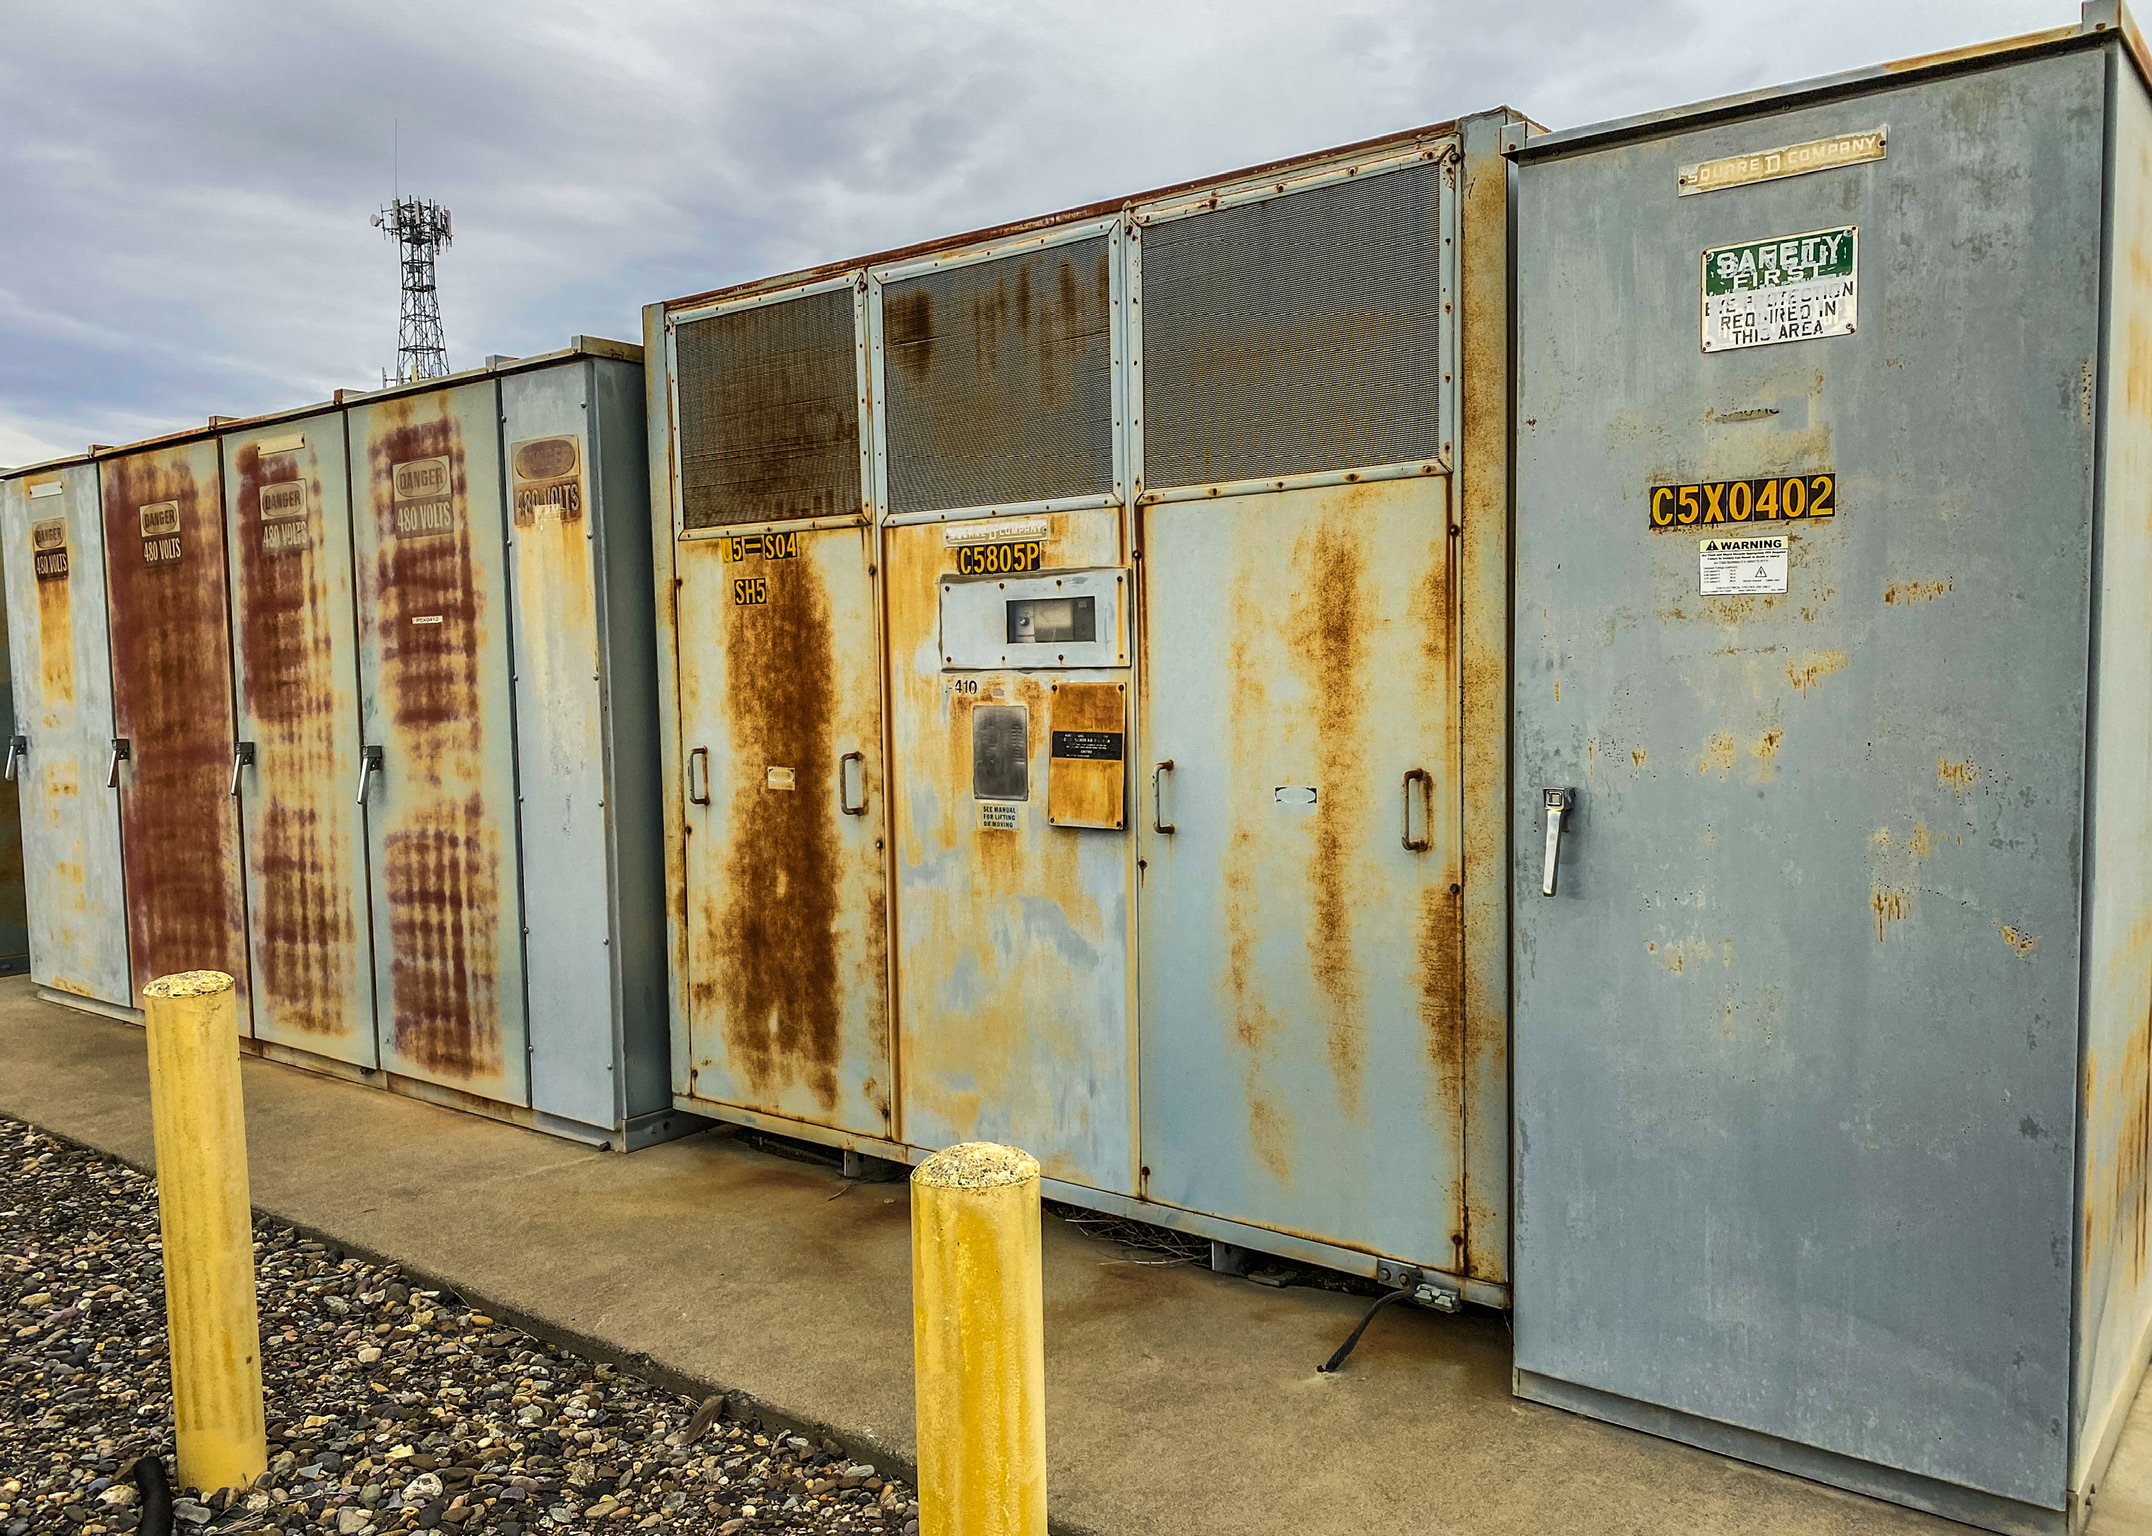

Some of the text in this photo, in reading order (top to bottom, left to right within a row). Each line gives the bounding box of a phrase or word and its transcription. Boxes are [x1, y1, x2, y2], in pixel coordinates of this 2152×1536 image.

[1687, 136, 1877, 183] SQUARE D COMPANY
[1716, 234, 1843, 275] SAFETY
[1733, 265, 1820, 290] FIRST
[1720, 304, 1811, 331] REQIRED
[1778, 319, 1824, 340] AREA
[399, 467, 444, 490] DANGER
[264, 489, 302, 511] DANGER
[1651, 475, 1834, 526] C5X0402
[144, 509, 176, 528] DANGER
[397, 501, 451, 533] 480 VOLTS
[35, 527, 62, 543] DANGER
[263, 521, 307, 549] 480 VOLTS
[1720, 540, 1782, 550] WARNING
[144, 537, 181, 562] 480 VOLTS
[960, 542, 1039, 575] C5805P
[36, 553, 68, 575] 480 VOLTS
[735, 579, 766, 604] SH5
[983, 805, 993, 813] SEE
